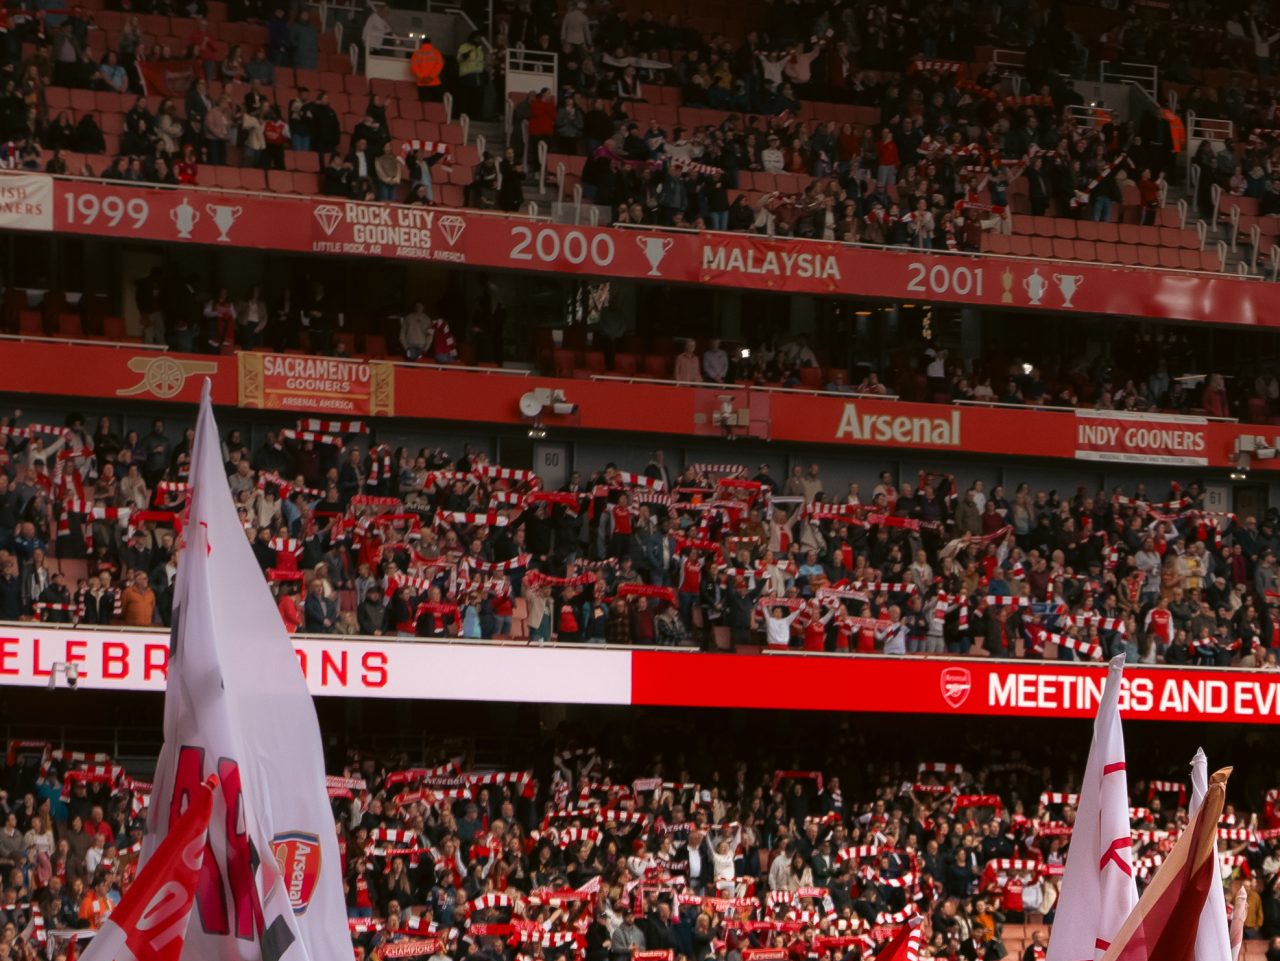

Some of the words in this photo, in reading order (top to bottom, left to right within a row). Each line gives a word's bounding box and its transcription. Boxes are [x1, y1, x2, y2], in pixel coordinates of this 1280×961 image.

[0, 202, 43, 216] NERS
[64, 192, 149, 229] 1999
[345, 202, 393, 226] ROCK
[397, 209, 434, 229] CITY
[353, 224, 432, 248] GOONERS
[509, 225, 616, 267] 2000
[703, 245, 842, 281] MALAYSIA
[906, 262, 984, 297] 2001
[263, 355, 371, 383] SACRAMENTO
[286, 377, 351, 393] GOONERS
[836, 402, 961, 446] Arsenal
[1078, 424, 1120, 446] INDY
[1125, 427, 1205, 451] GOONERS
[1160, 679, 1228, 714] AND
[288, 842, 311, 907] Arsenal
